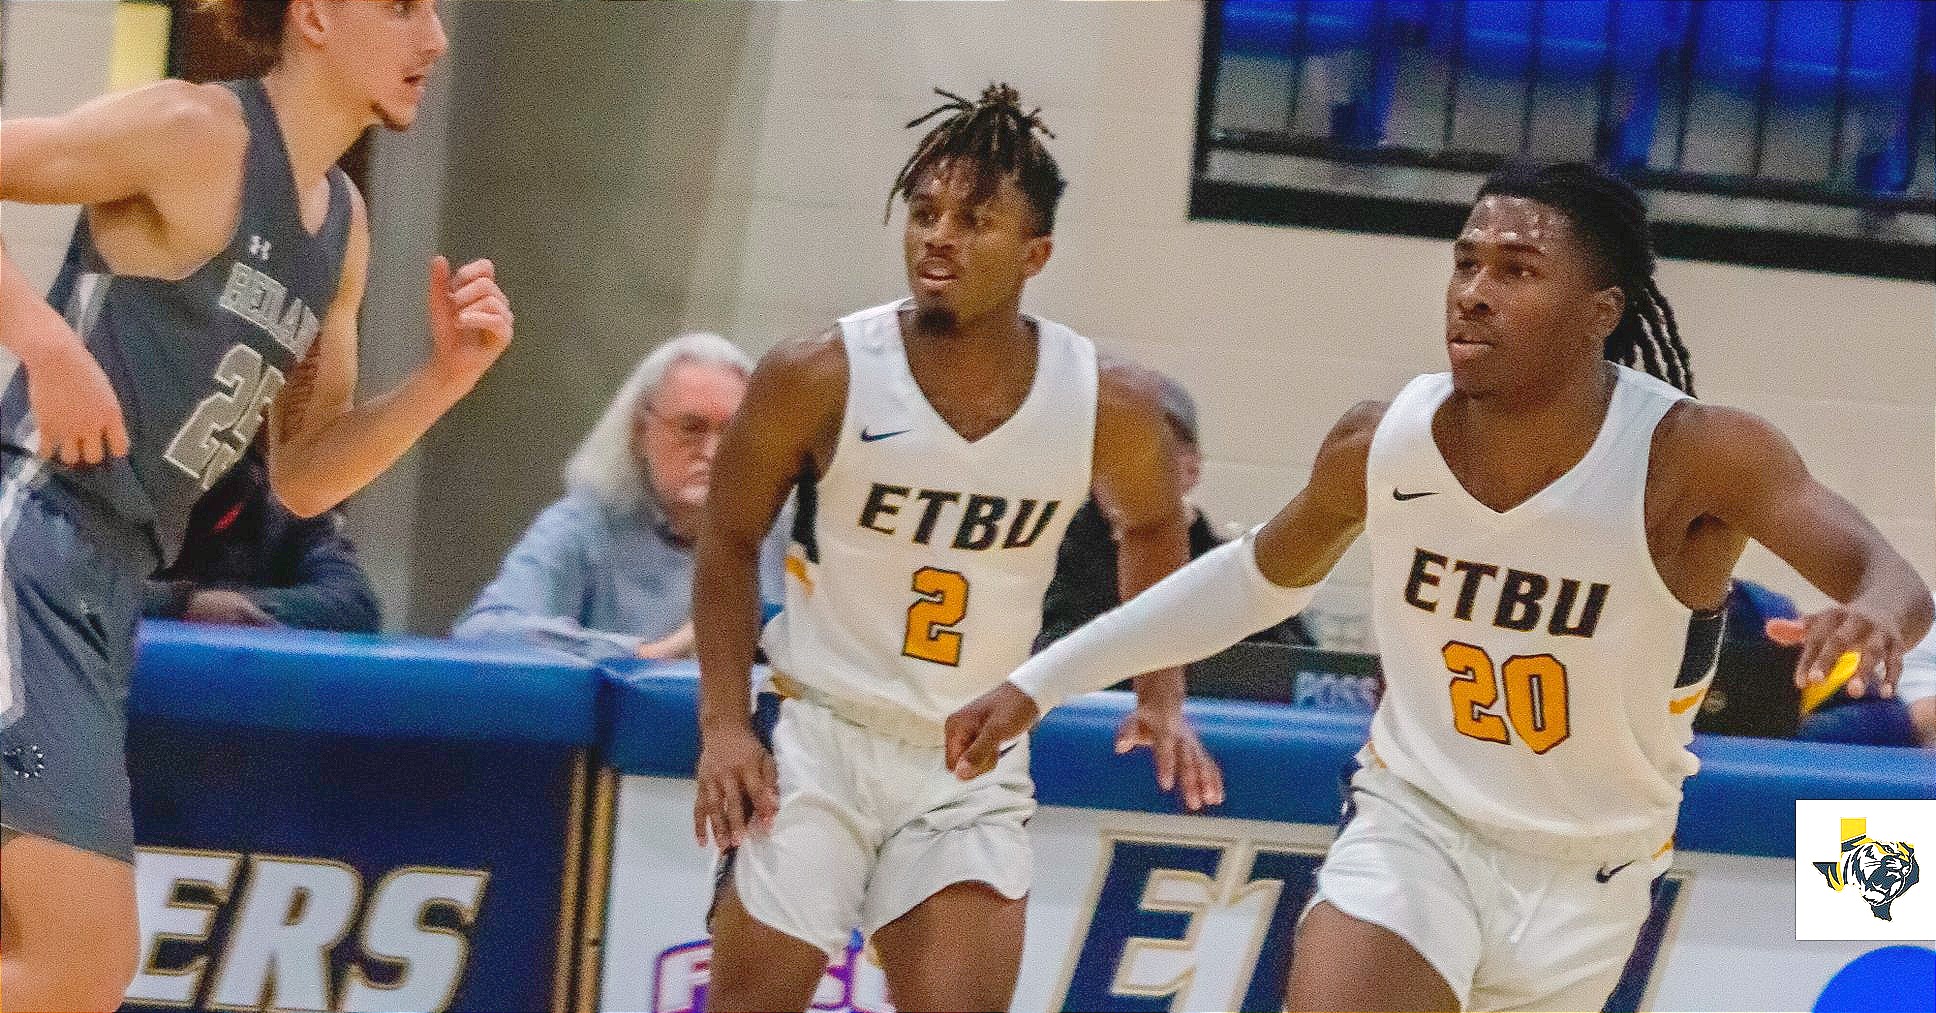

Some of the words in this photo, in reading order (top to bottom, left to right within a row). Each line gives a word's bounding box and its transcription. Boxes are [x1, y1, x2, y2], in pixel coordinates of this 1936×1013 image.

[858, 482, 1061, 551] ETBU
[902, 566, 969, 667] 2
[1404, 547, 1610, 638] ETBU
[1441, 640, 1571, 755] 20
